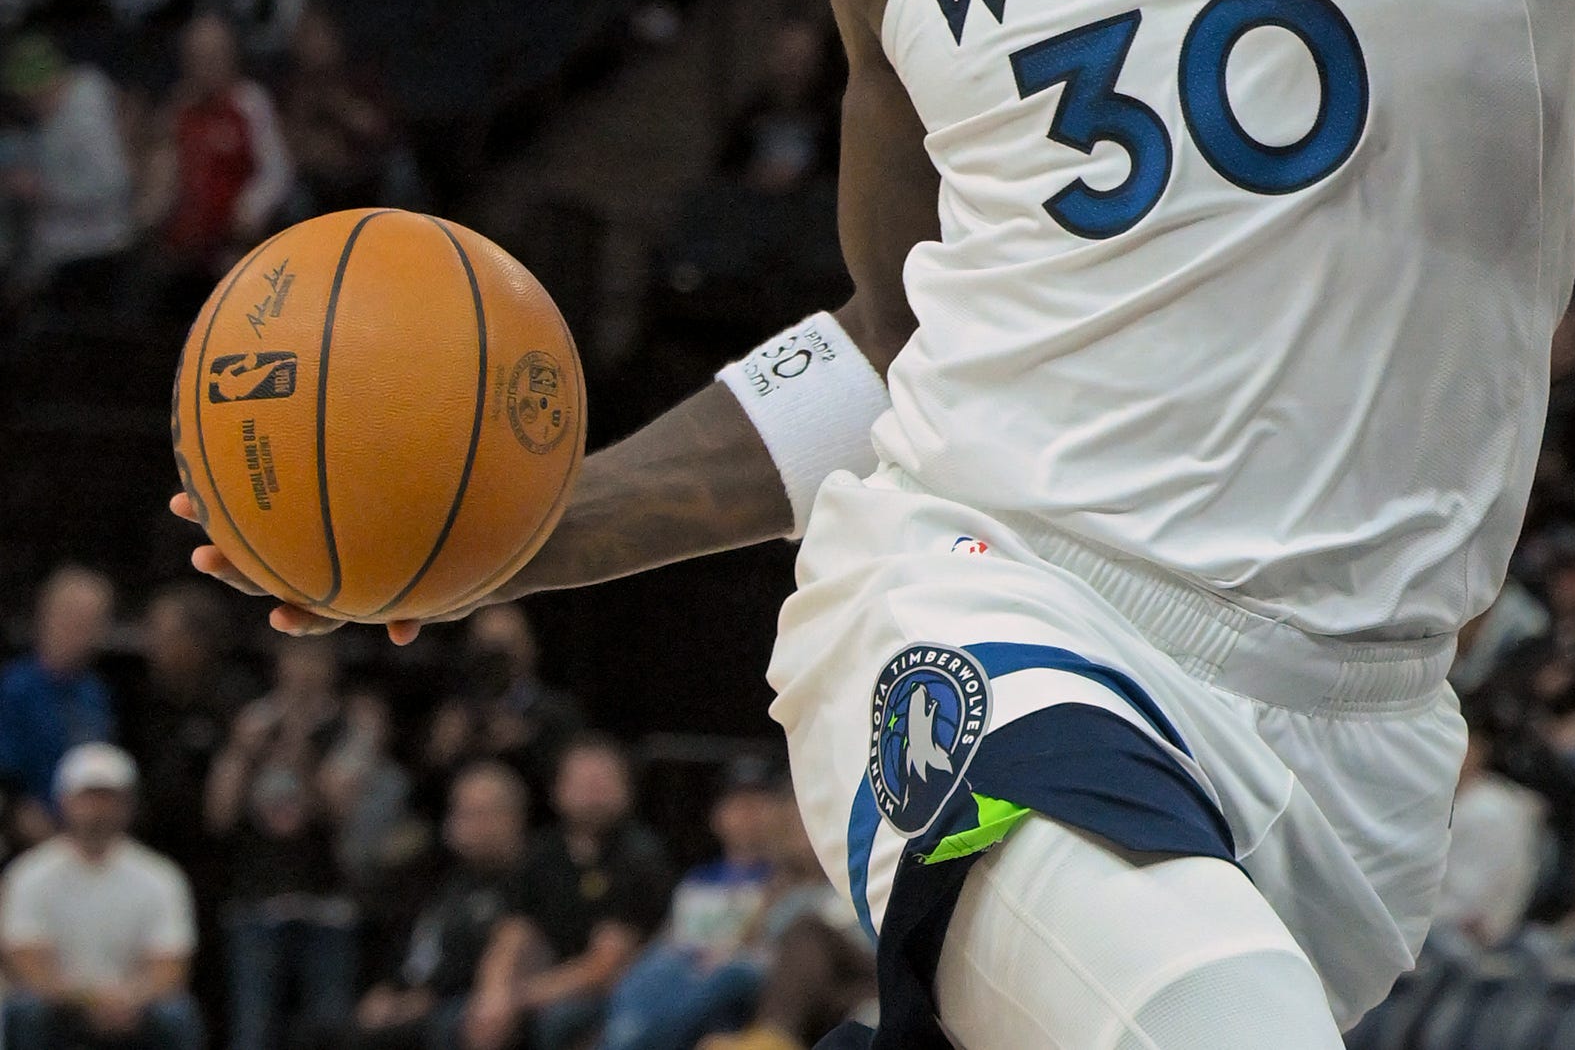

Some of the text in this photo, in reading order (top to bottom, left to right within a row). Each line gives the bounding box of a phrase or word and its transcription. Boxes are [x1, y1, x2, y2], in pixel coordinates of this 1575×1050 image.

[274, 366, 291, 394] NBA
[761, 335, 813, 379] 30
[242, 418, 272, 511] OFFICIAL GAME BALL
[890, 650, 984, 746] TIMBERWOLVES
